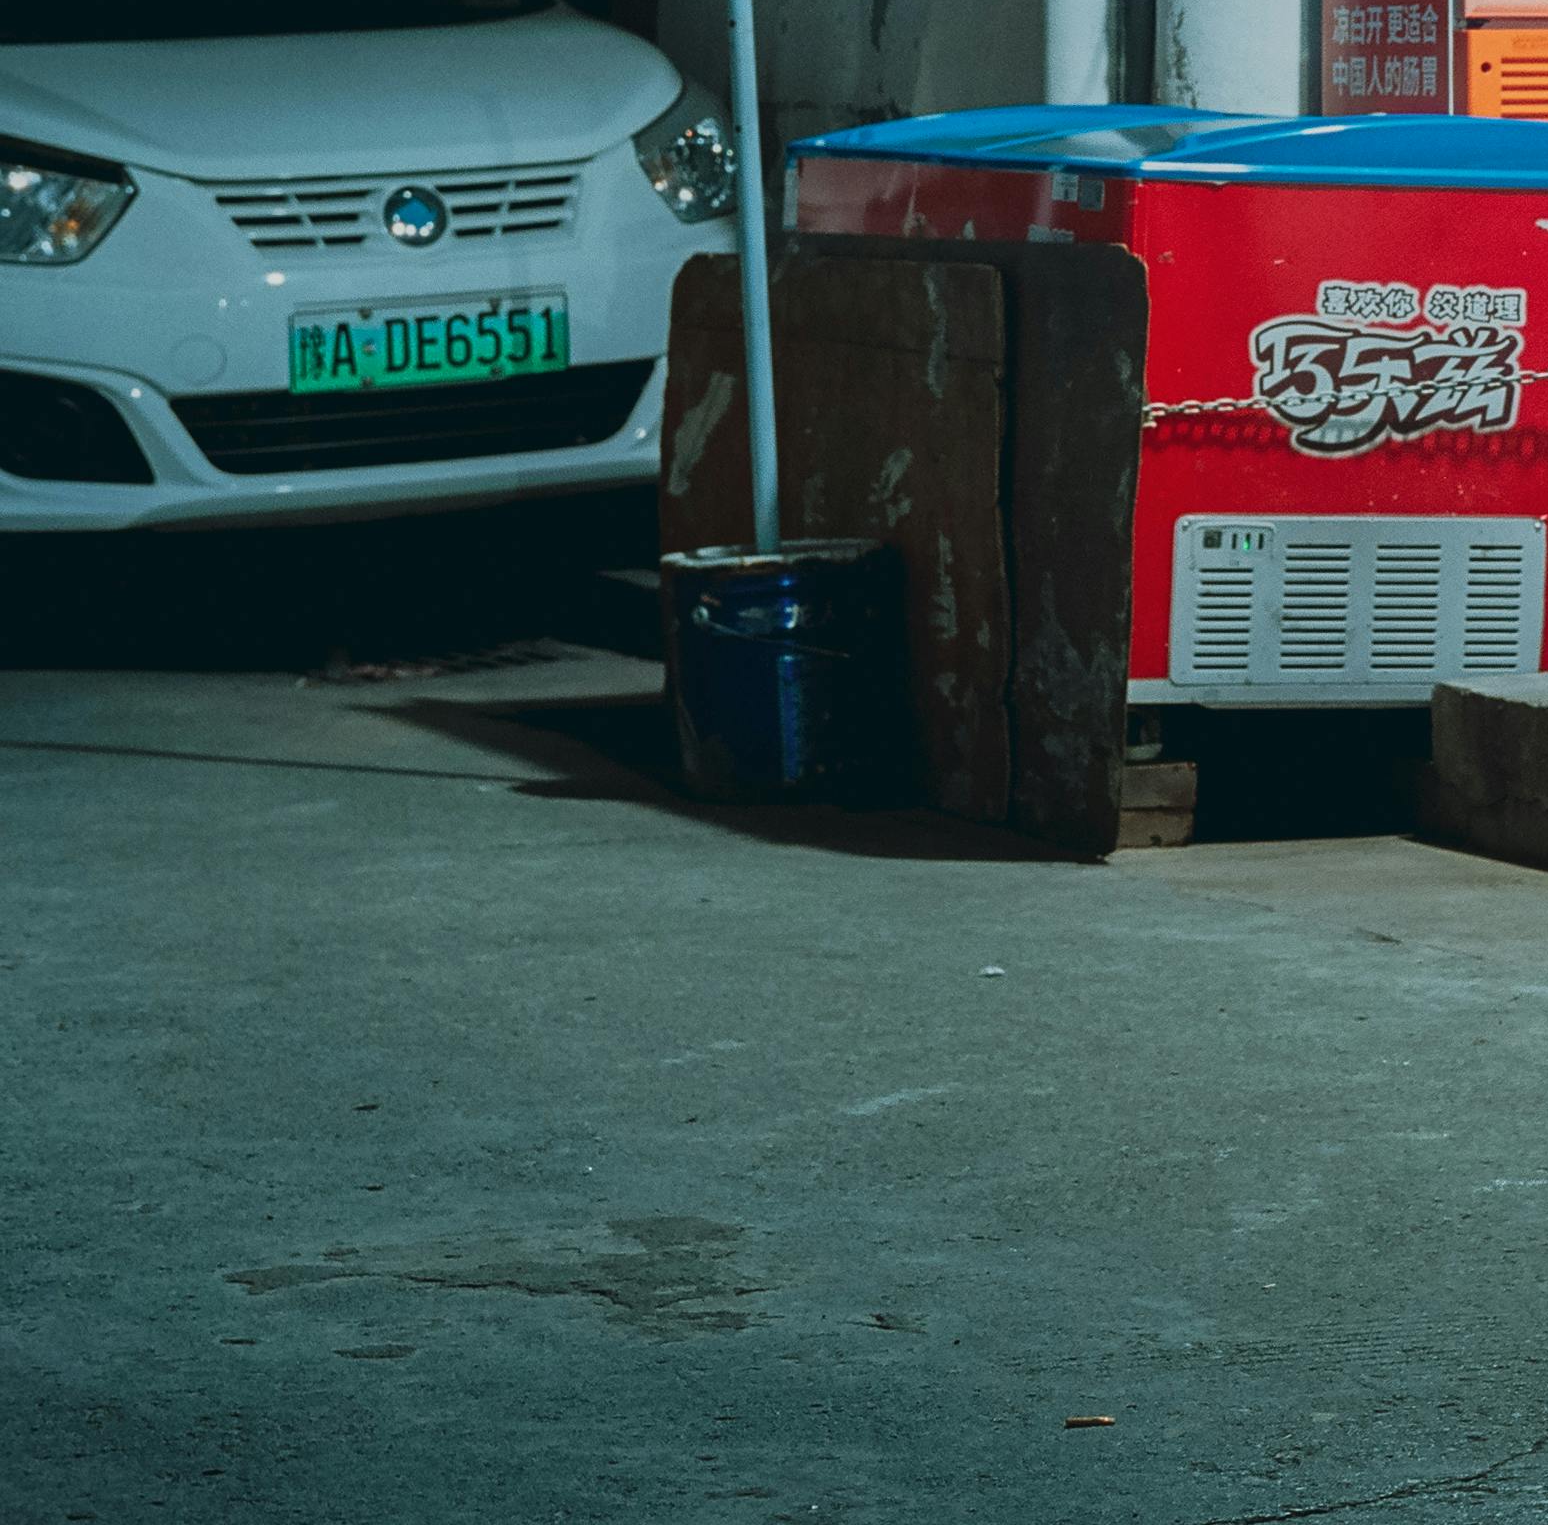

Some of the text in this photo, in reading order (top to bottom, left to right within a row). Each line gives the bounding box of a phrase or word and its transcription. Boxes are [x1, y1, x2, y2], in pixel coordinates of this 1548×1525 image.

[1332, 3, 1440, 46] 凉白开 更适合
[1332, 55, 1439, 98] 中国人的肠胃
[1321, 284, 1522, 323] 喜欢你 没道理
[1256, 318, 1519, 455] 巧乐兹
